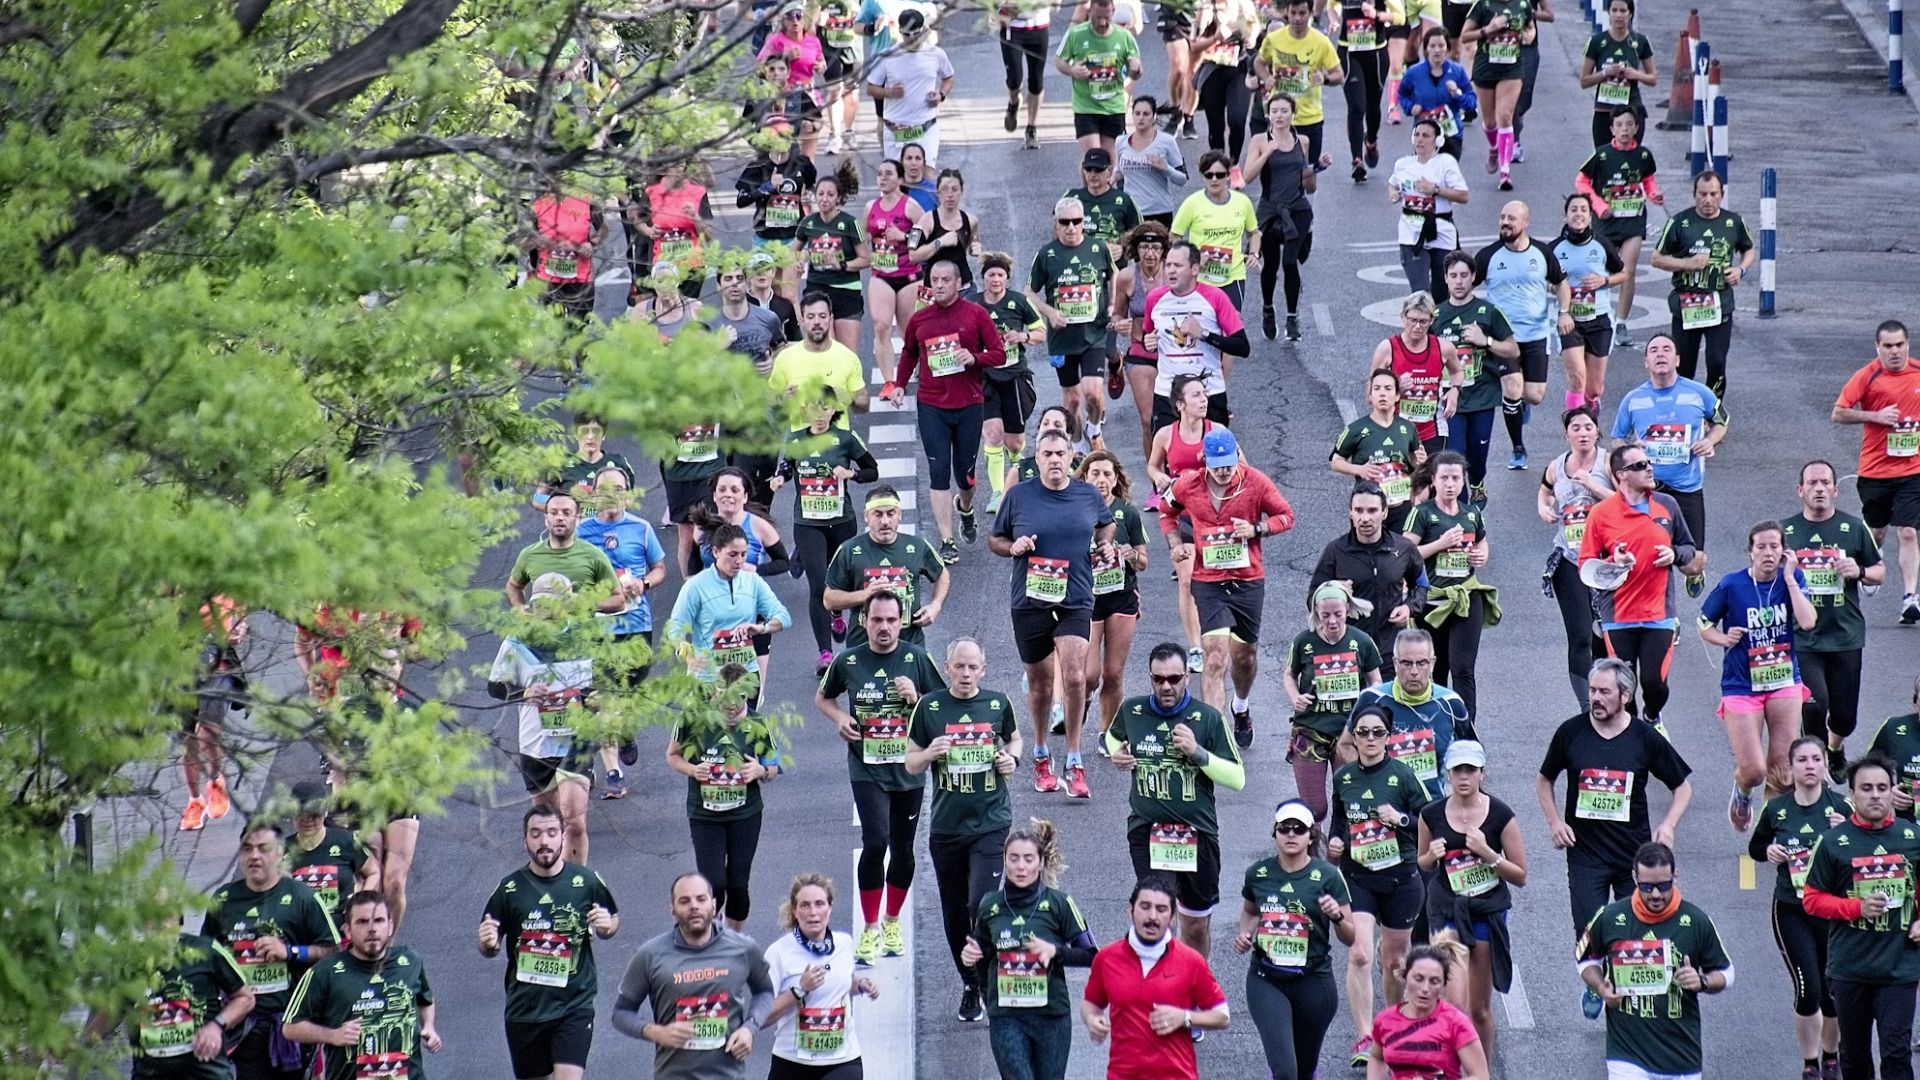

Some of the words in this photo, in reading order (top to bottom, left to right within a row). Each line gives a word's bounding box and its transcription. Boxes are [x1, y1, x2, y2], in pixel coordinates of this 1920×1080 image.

[1411, 376, 1438, 385] NMARK
[1748, 628, 1769, 641] FOR
[1771, 624, 1787, 638] THE
[1136, 743, 1164, 753] MADRID
[962, 750, 985, 762] 41756
[1592, 797, 1615, 810] 42572
[1165, 849, 1188, 860] 41644
[1260, 905, 1286, 913] MADRID
[521, 921, 551, 931] MADRID
[534, 959, 559, 974] 42859
[1630, 970, 1656, 983] 42659
[352, 1000, 385, 1012] MADRID
